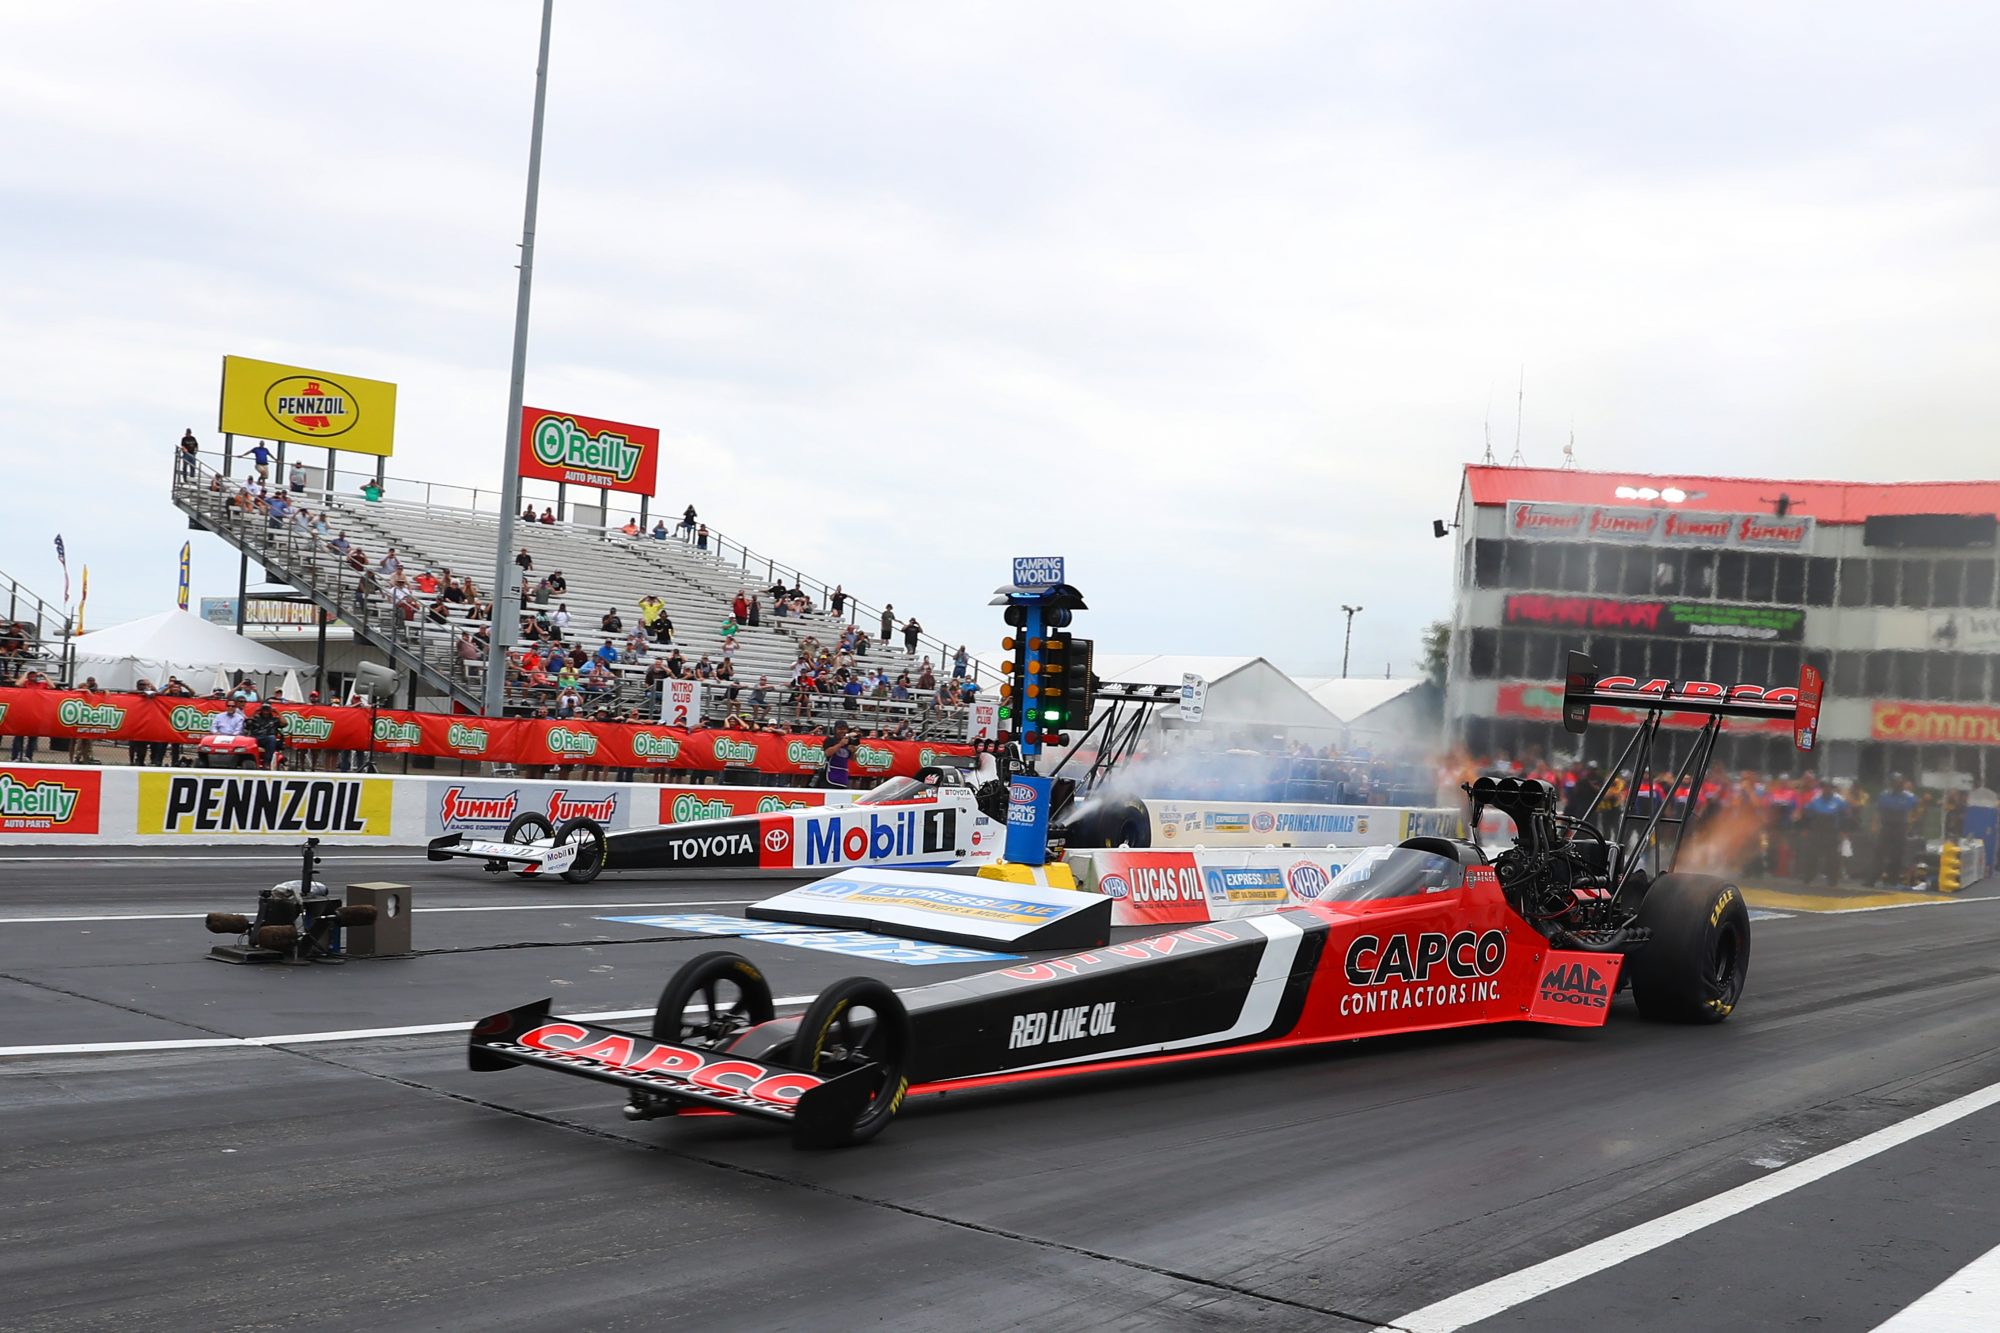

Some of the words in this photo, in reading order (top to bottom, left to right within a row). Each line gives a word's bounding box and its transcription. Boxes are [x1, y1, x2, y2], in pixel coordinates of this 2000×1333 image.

[278, 397, 344, 414] PENNZOIL
[536, 418, 638, 477] O'Reilly
[565, 470, 585, 483] AUTO
[587, 473, 612, 486] PARTS
[1015, 558, 1061, 570] CAMPING
[1015, 569, 1061, 583] WORLD
[672, 682, 693, 693] NITRO
[673, 693, 691, 703] CLUB
[61, 701, 123, 729] O'Reilly
[673, 705, 688, 724] 2
[976, 706, 993, 716] NITRO
[977, 716, 992, 725] CLUB
[374, 718, 420, 744] O'Reilly
[448, 724, 488, 750] O'Reilly
[548, 728, 596, 755] O'Reilly
[634, 733, 678, 758] O'Reilly
[714, 738, 756, 763] O'Reilly
[856, 746, 893, 769] O'Reilly
[0, 777, 75, 819] 'Reilly
[165, 777, 366, 830] PENNZOIL
[442, 788, 517, 828] SUMMIT
[4, 820, 24, 828] AUTO
[26, 820, 50, 828] PARTS
[1008, 812, 1036, 823] ORLD
[1276, 813, 1356, 832] SPRINGNATIONALS
[669, 834, 754, 860] TOYOTA
[806, 811, 915, 866] Mobil
[547, 850, 567, 861] Mobil
[1103, 877, 1128, 897] NHRA
[1129, 867, 1178, 902] LUCAS
[1178, 867, 1204, 901] OIL
[1294, 867, 1327, 898] NHRA
[1711, 889, 1733, 928] EAGLE
[1344, 929, 1506, 986] CAPCO
[1541, 964, 1607, 996] MAC
[1340, 984, 1466, 1016] CONTRACTORS
[1472, 980, 1500, 1001] INC.
[1539, 990, 1606, 1008] TOOLS
[1009, 1013, 1049, 1049] RED
[1048, 1007, 1088, 1043] LINE
[1090, 1002, 1117, 1036] OIL
[516, 1023, 825, 1106] CAPCO
